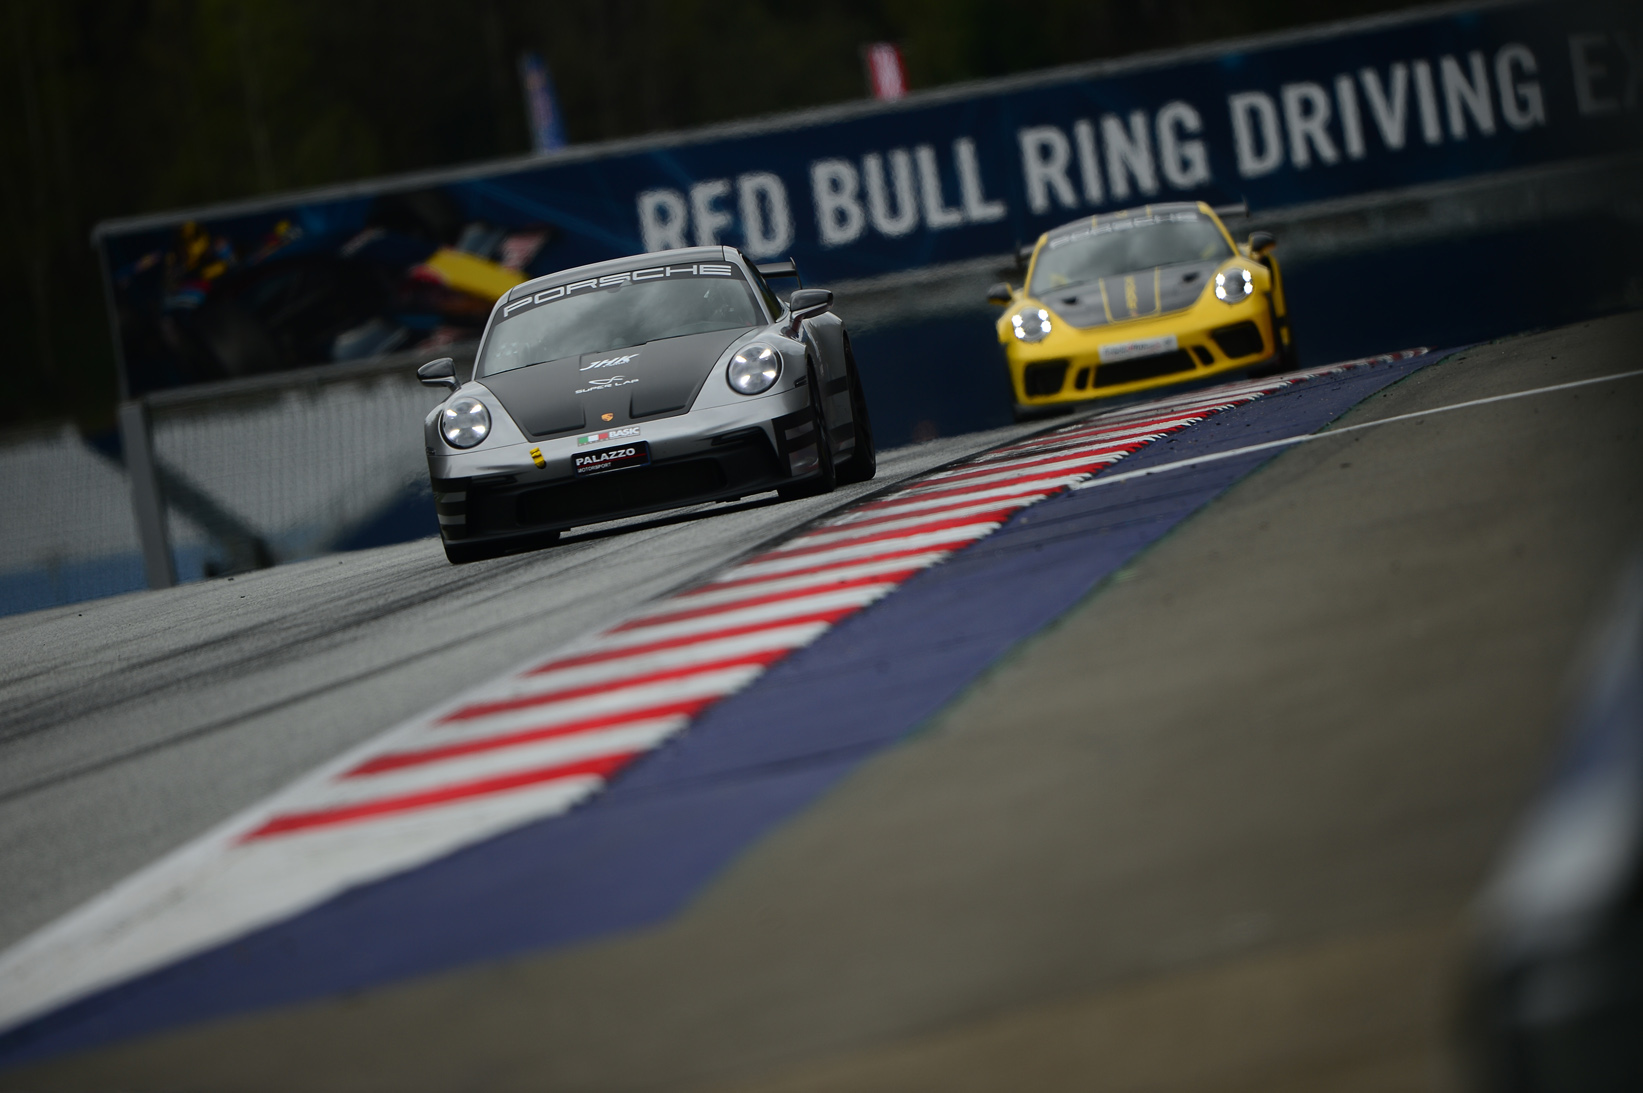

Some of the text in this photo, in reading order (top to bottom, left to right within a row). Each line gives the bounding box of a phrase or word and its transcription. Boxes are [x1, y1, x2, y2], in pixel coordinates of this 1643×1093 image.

[636, 170, 793, 258] RED
[811, 138, 1005, 246] BULL
[1020, 101, 1210, 212] RING
[1229, 44, 1546, 178] DRIVING
[503, 264, 732, 318] PORSCHE
[575, 384, 612, 394] SUPER
[609, 427, 639, 438] BASIC
[576, 448, 635, 465] PALAZZO
